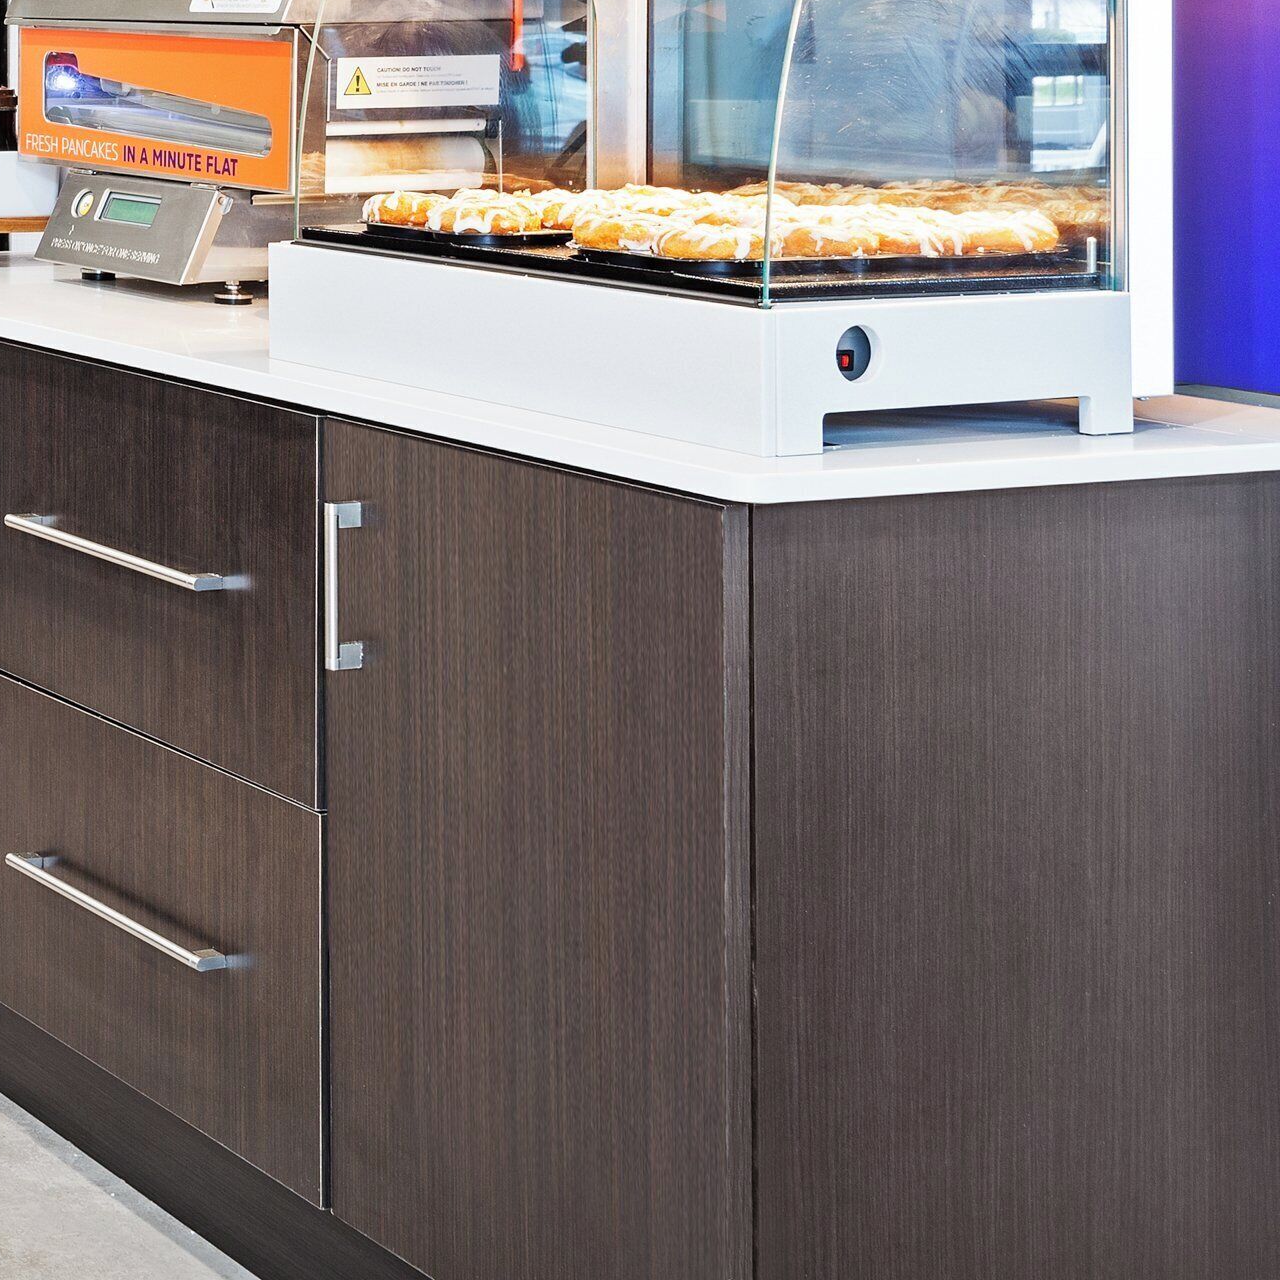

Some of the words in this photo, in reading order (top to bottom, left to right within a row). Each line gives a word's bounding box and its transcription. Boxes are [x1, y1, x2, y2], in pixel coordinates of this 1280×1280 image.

[25, 133, 58, 153] FRESH
[61, 137, 119, 162] PANCAKES
[123, 145, 135, 163] IN
[140, 147, 148, 164] A
[153, 149, 201, 172] MINUTE
[206, 156, 238, 176] FLAT
[51, 237, 72, 249] PRESS
